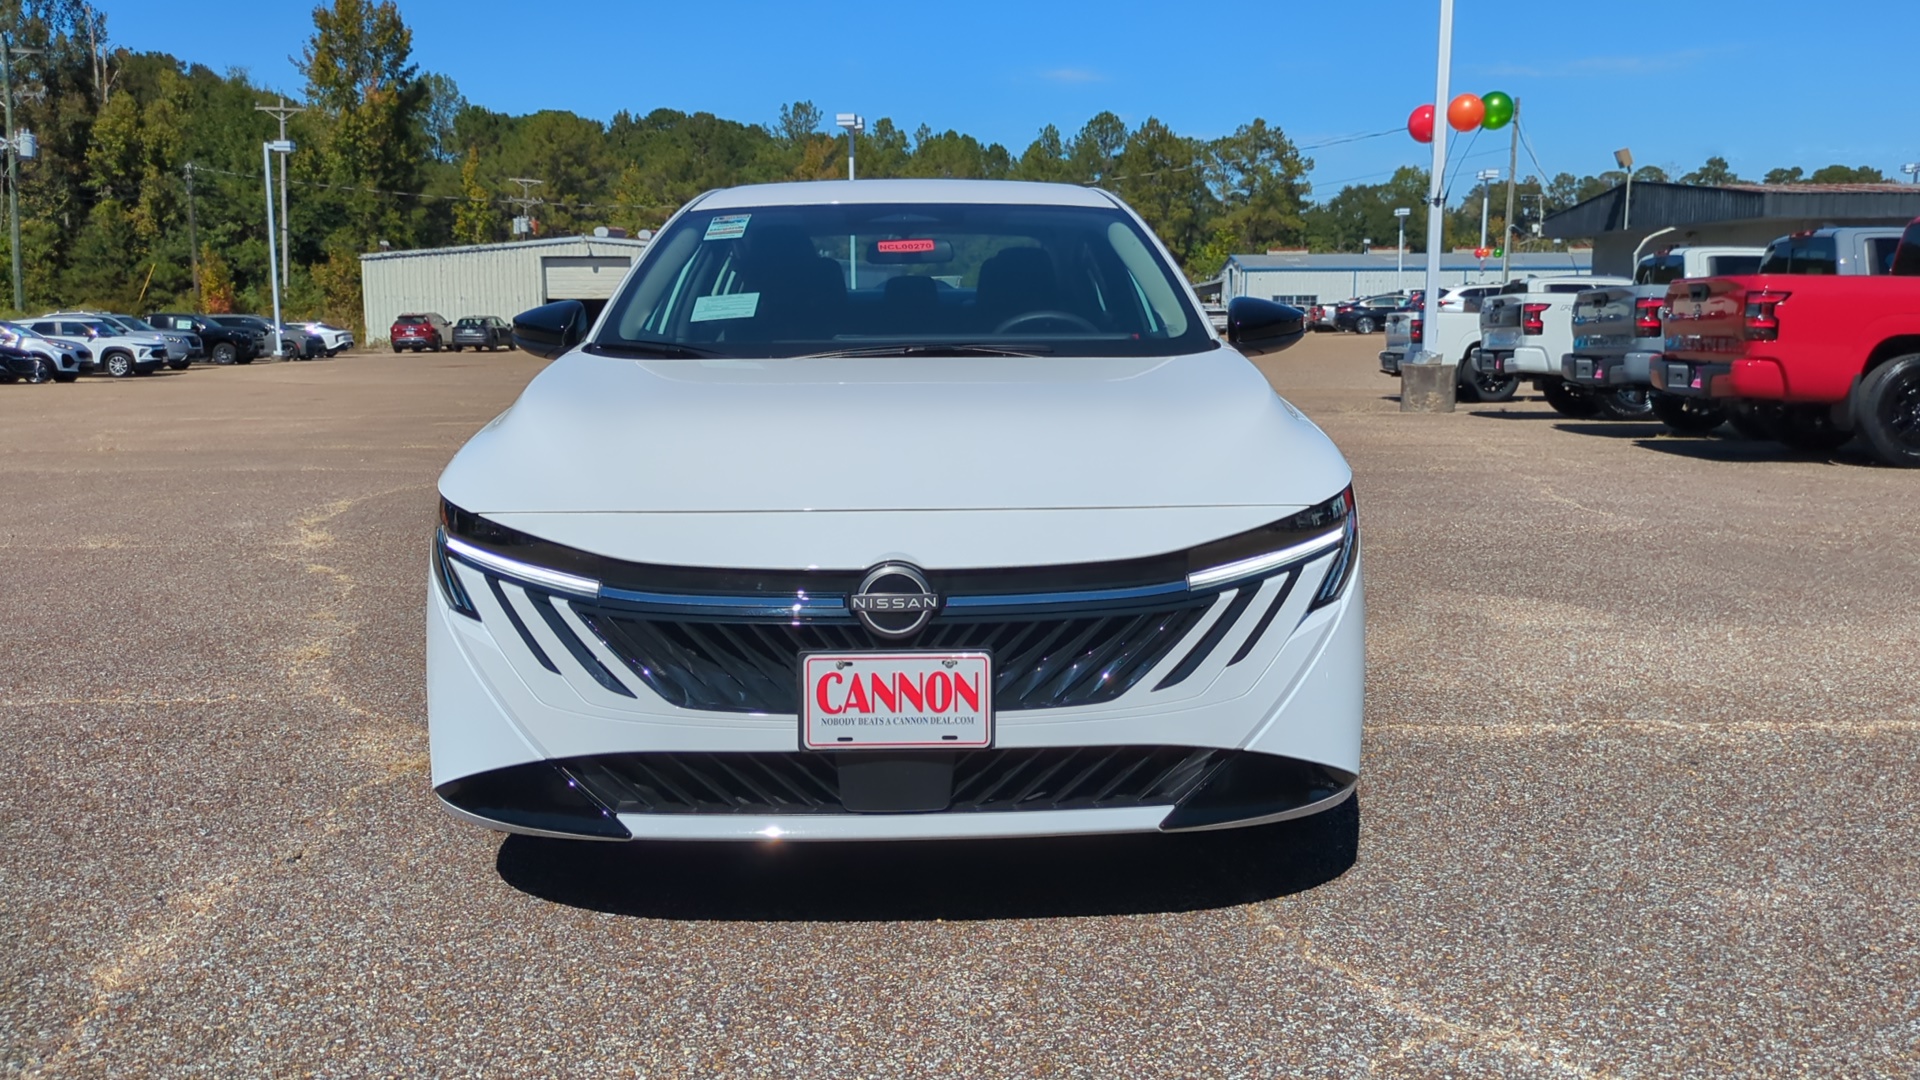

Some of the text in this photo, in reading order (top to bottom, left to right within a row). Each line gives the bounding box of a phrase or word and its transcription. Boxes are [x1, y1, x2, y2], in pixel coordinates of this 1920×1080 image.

[853, 597, 937, 609] NISSAN
[816, 671, 979, 714] CANNON
[821, 716, 975, 727] NOBODY BEATS A CANNON DEAL.COM
